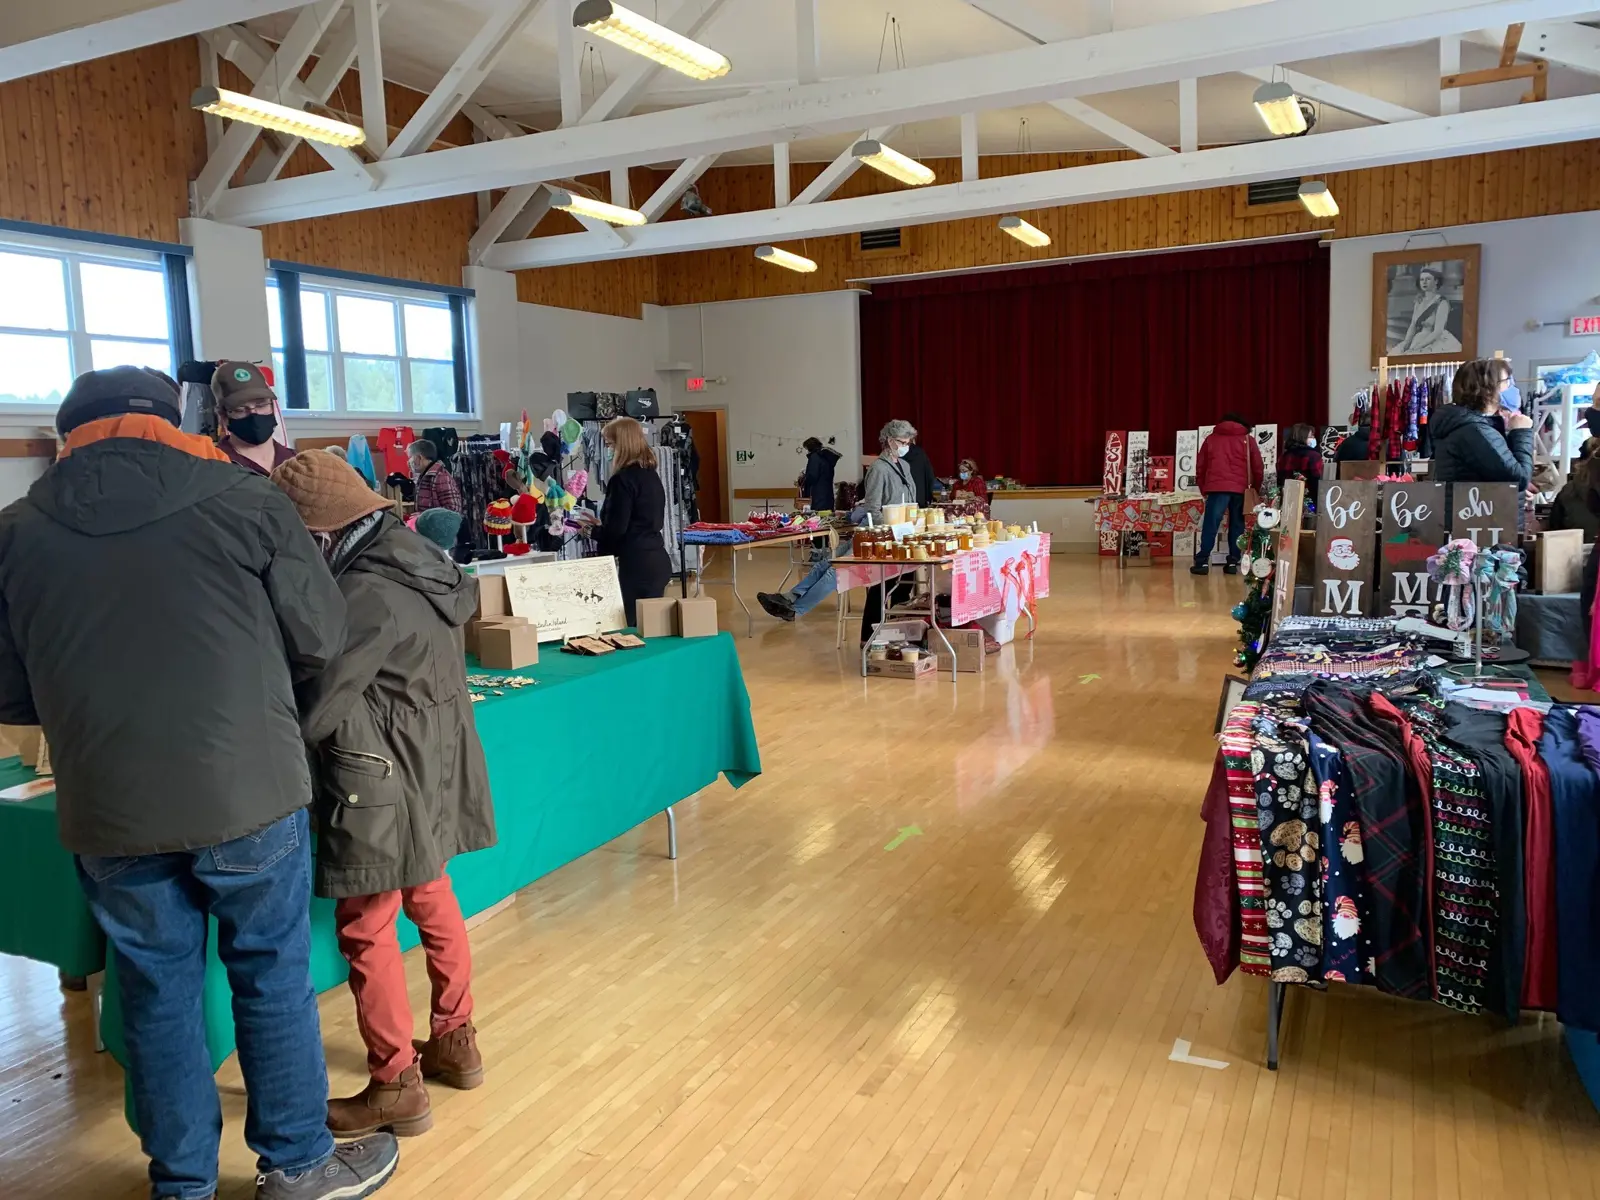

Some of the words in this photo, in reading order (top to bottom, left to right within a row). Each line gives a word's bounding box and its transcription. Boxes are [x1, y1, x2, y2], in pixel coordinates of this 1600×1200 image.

[1573, 316, 1600, 334] EXIT
[1325, 485, 1366, 529] be
[1390, 490, 1432, 528] be
[1458, 486, 1493, 520] oh
